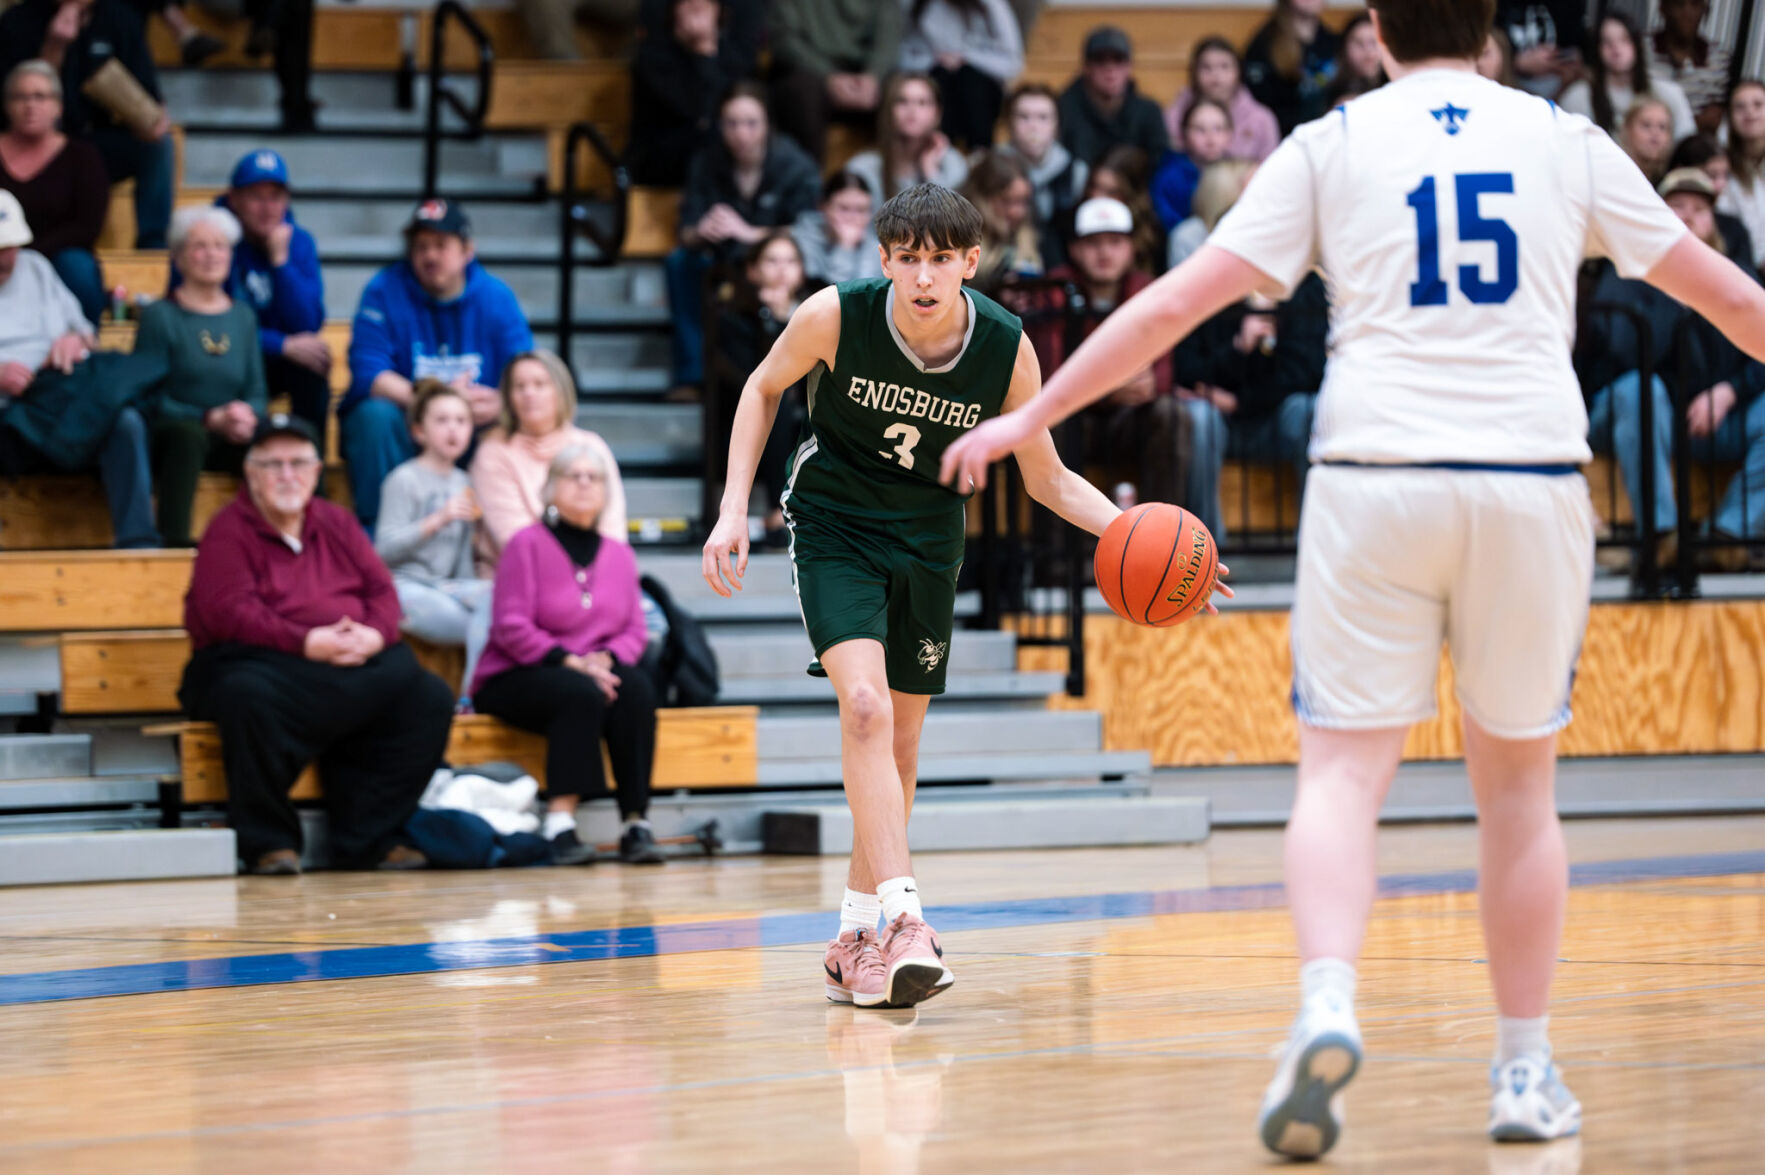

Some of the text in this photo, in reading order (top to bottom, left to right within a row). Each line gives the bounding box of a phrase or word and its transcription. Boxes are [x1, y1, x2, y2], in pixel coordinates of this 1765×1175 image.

[1406, 172, 1518, 307] 15
[847, 376, 982, 429] ENOSBURG
[878, 422, 922, 471] 3
[1166, 526, 1207, 607] SPALDING
